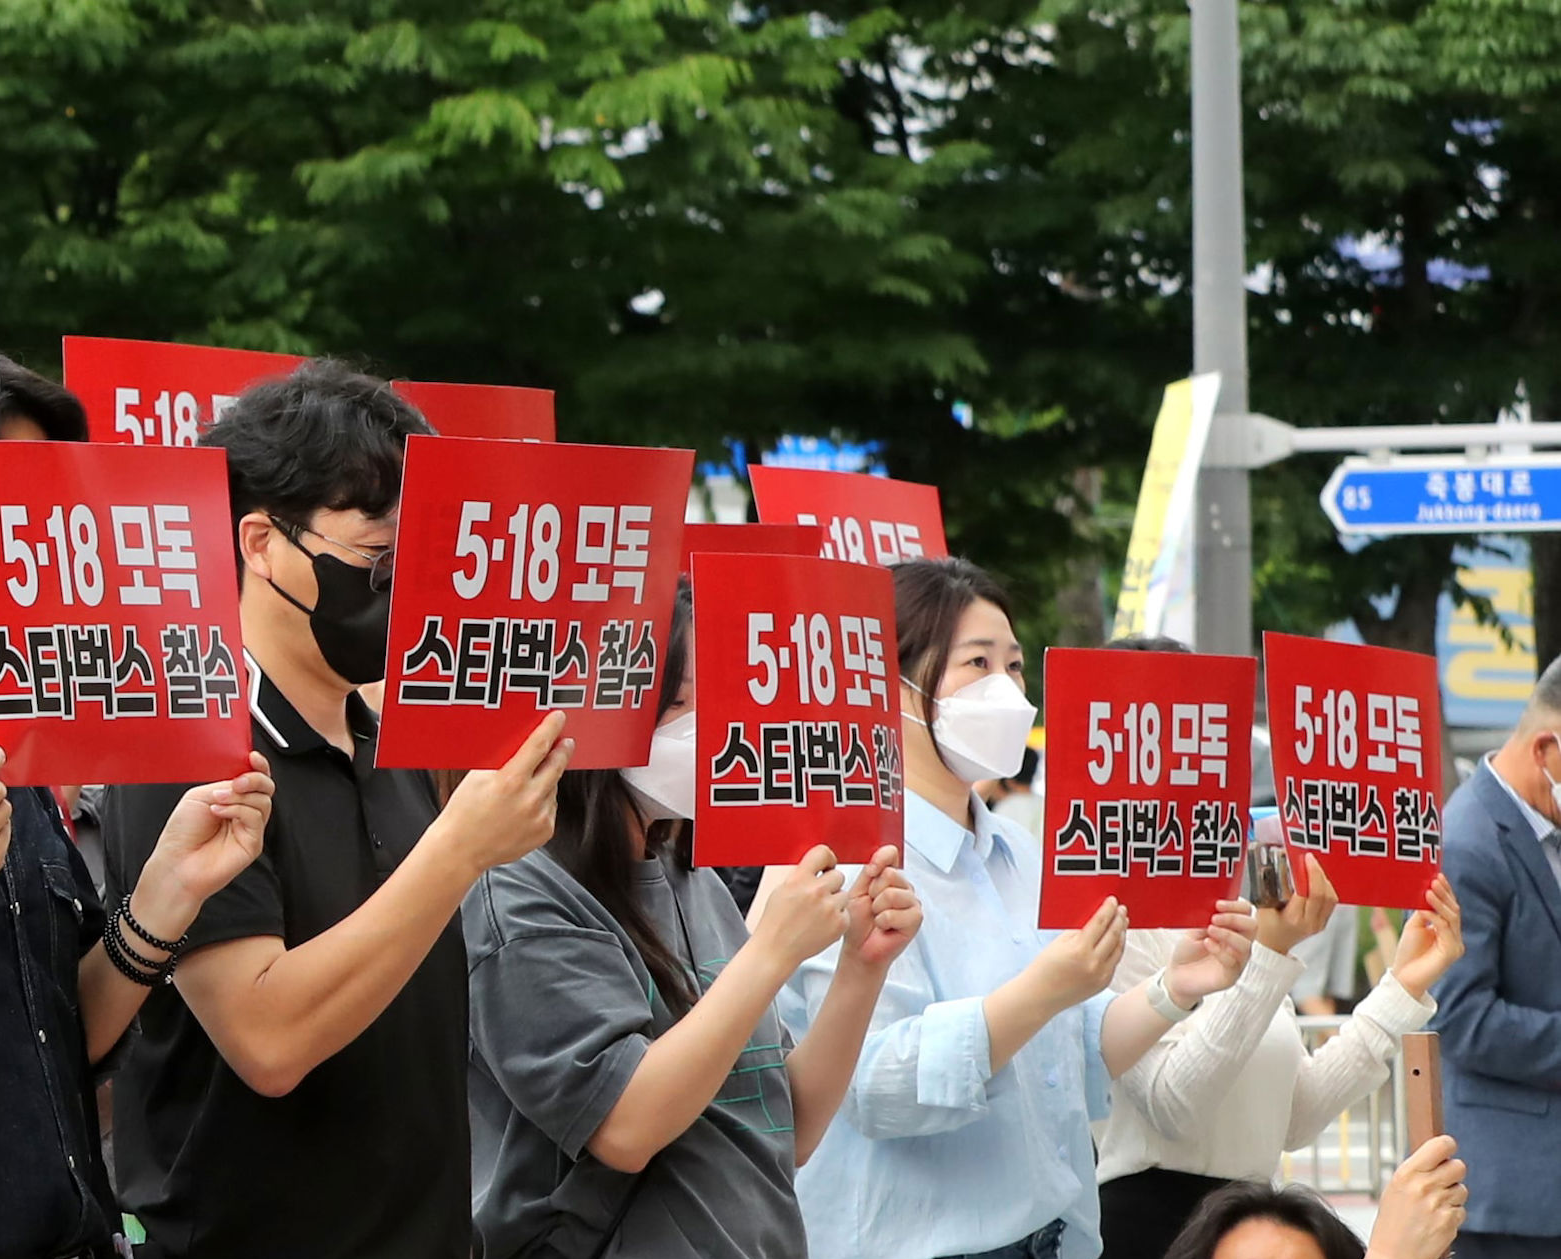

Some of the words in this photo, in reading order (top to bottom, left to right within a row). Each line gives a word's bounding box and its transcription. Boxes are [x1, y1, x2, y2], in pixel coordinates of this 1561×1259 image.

[109, 505, 202, 608] 모독
[571, 504, 653, 605] 모독
[161, 623, 241, 720] 철수
[397, 615, 589, 711] 스타벅스
[591, 618, 657, 710] 철수
[839, 614, 889, 712] 모독
[709, 720, 876, 808] 스타벅스
[871, 723, 903, 813] 철수
[1169, 702, 1229, 789] 모독
[1366, 692, 1425, 779] 모독
[1053, 798, 1185, 879] 스타벅스
[1189, 799, 1244, 879] 철수
[1282, 774, 1388, 858] 스타벅스
[1394, 786, 1442, 866] 철수
